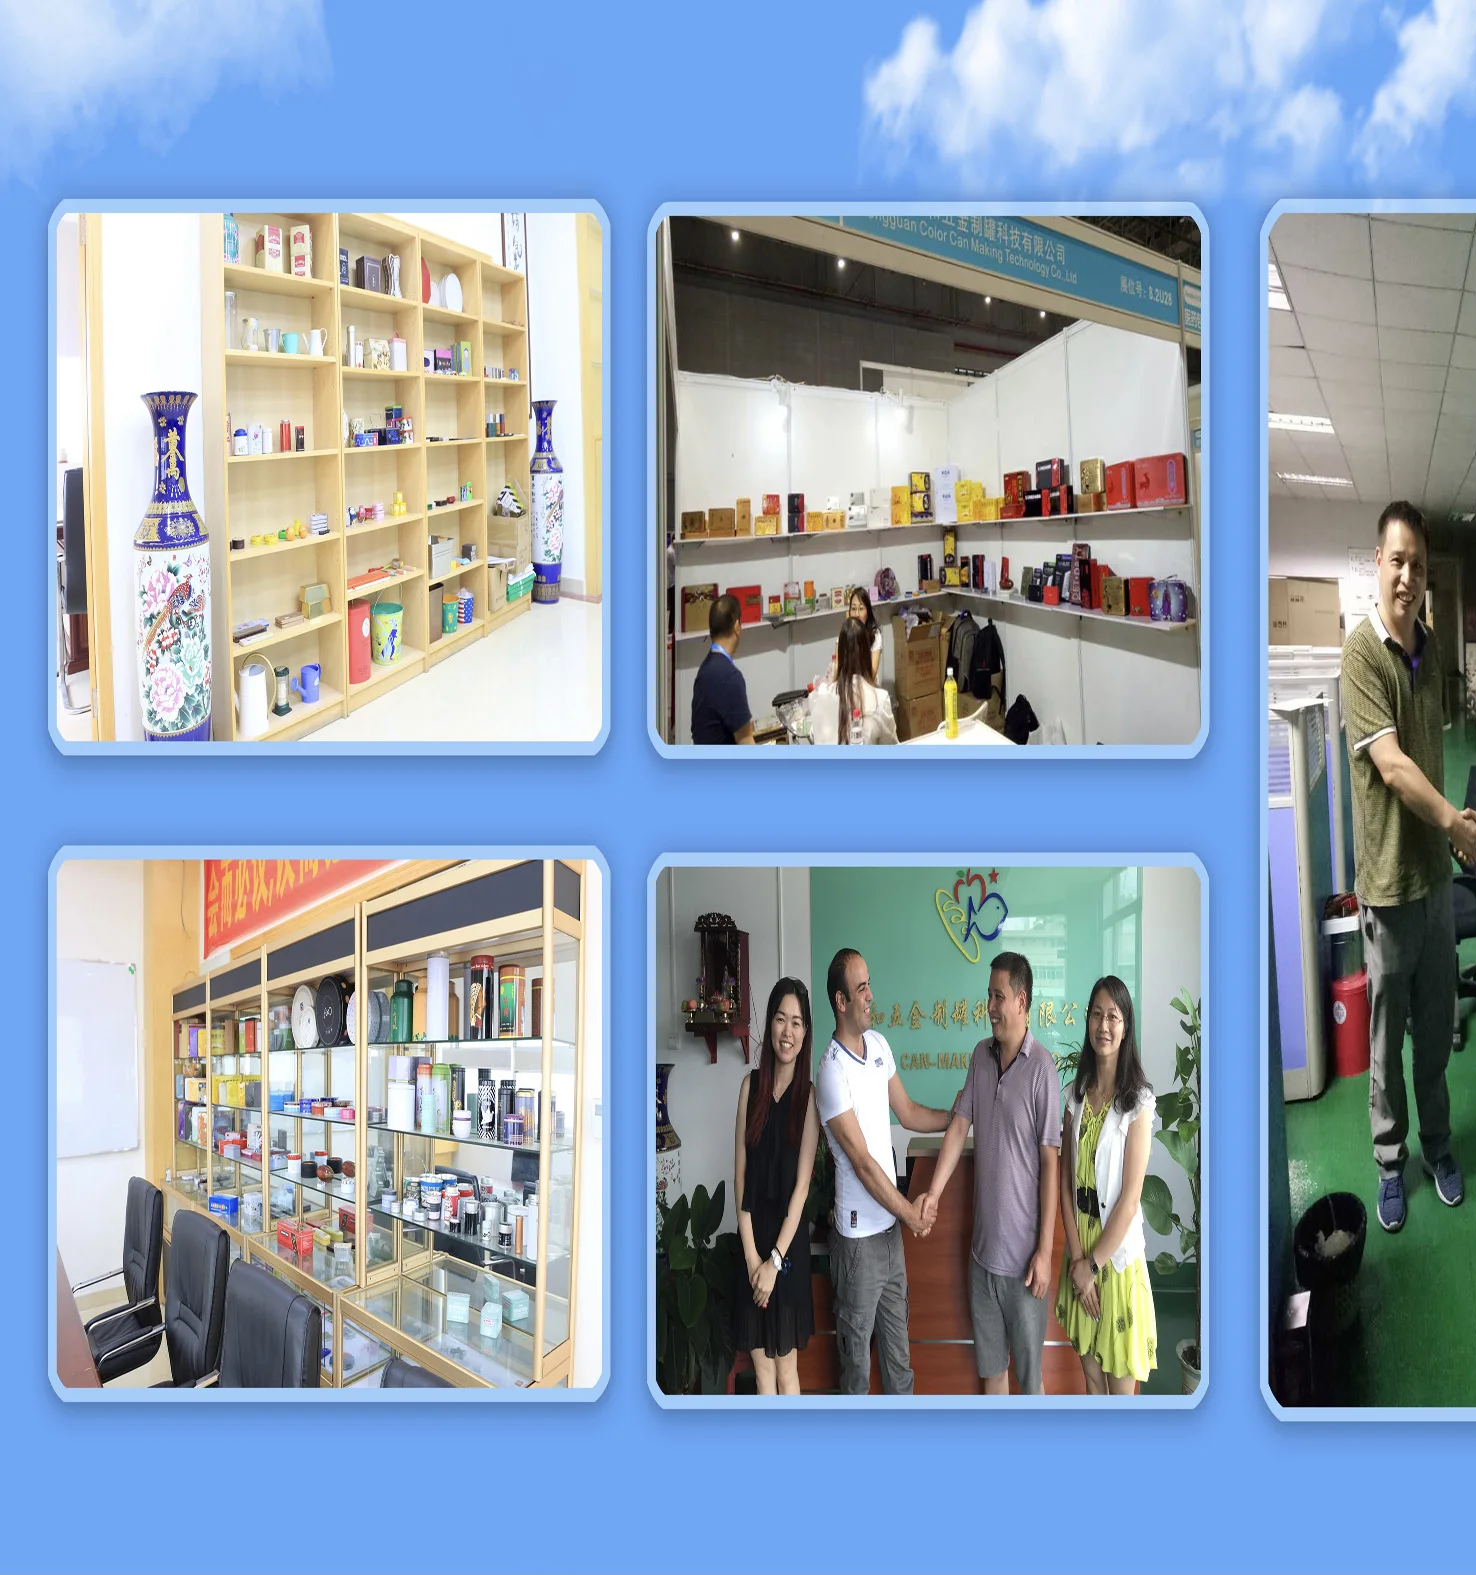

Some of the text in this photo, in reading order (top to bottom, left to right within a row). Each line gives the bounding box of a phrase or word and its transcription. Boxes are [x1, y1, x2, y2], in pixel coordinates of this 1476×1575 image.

[920, 221, 947, 242] Color
[949, 231, 969, 250] Can
[971, 238, 1003, 264] Making
[1005, 248, 1050, 278] Technology
[929, 216, 1066, 265] 五金制罐科技有限公司
[901, 1052, 972, 1070] CAN-MAK
